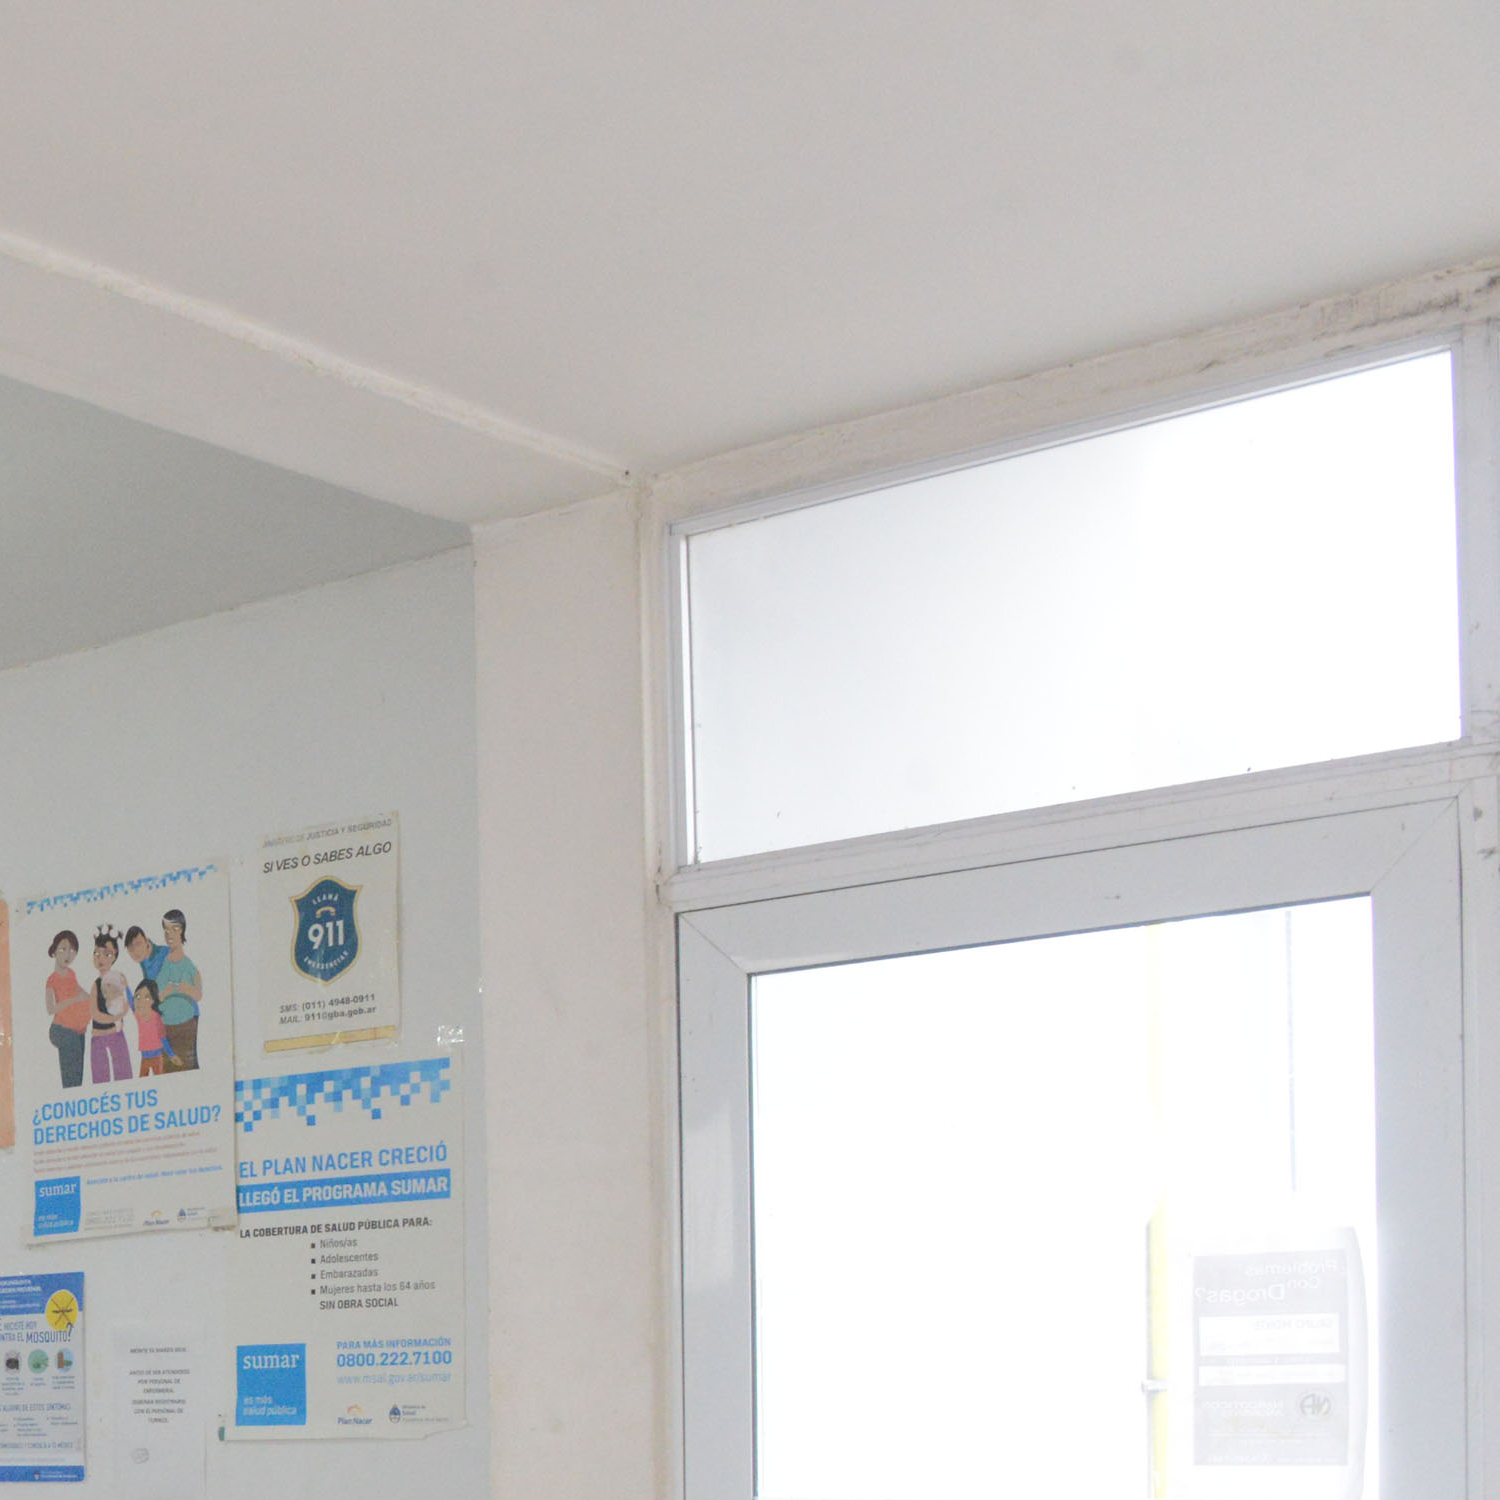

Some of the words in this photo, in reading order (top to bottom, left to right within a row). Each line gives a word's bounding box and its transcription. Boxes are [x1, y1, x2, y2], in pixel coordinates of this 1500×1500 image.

[307, 829, 338, 840] JUSTICIA
[348, 819, 392, 832] SEGURIDAD
[263, 861, 273, 874] SI
[276, 856, 298, 871] VES
[301, 855, 310, 866] O
[313, 847, 353, 865] SABES
[356, 841, 392, 858] ALGO
[308, 920, 345, 949] 911
[302, 1001, 326, 1012] (011)
[329, 994, 375, 1006] 4948-0911
[32, 1092, 121, 1126] ¿CONOCÉS
[125, 1089, 158, 1109] TUS
[34, 1117, 124, 1145] DERECHOS
[128, 1114, 150, 1133] DE
[154, 1105, 221, 1130] SALUD?
[239, 1161, 257, 1178] EL
[262, 1156, 306, 1176] PLAN
[312, 1150, 373, 1172] NACER
[379, 1140, 448, 1167] CRECIÓ
[39, 1183, 77, 1197] sumar
[239, 1187, 281, 1207] LLEGÓ
[284, 1188, 299, 1203] EL
[303, 1181, 388, 1202] PROGRAMA
[391, 1176, 448, 1196] SUMAR
[240, 1229, 250, 1238] LA
[253, 1224, 308, 1237] COBERTURA
[311, 1224, 322, 1234] DE
[325, 1222, 355, 1232] SALUD
[358, 1219, 399, 1231] PÚBLICA
[402, 1217, 433, 1227] PARA:
[320, 1237, 357, 1249] Niños/as
[320, 1252, 379, 1264] Adolescentes
[320, 1268, 379, 1279] Embarazadas
[320, 1285, 355, 1296] Mujeres
[357, 1283, 381, 1293] hasta
[384, 1281, 397, 1292] los
[400, 1281, 411, 1291] 64
[413, 1281, 436, 1291] años
[320, 1300, 335, 1310] SIN
[337, 1299, 363, 1309] OBRA
[365, 1297, 399, 1308] SOCIAL
[17, 1332, 24, 1341] EL
[26, 1322, 73, 1343] MOSQUITO?
[337, 1340, 361, 1350] PARA
[363, 1338, 384, 1349] MÁS
[386, 1336, 451, 1348] INFORMACIÓN
[243, 1354, 300, 1369] sumar
[337, 1350, 452, 1368] 0800.222.7100
[243, 1406, 266, 1415] salud
[267, 1406, 297, 1416] pública
